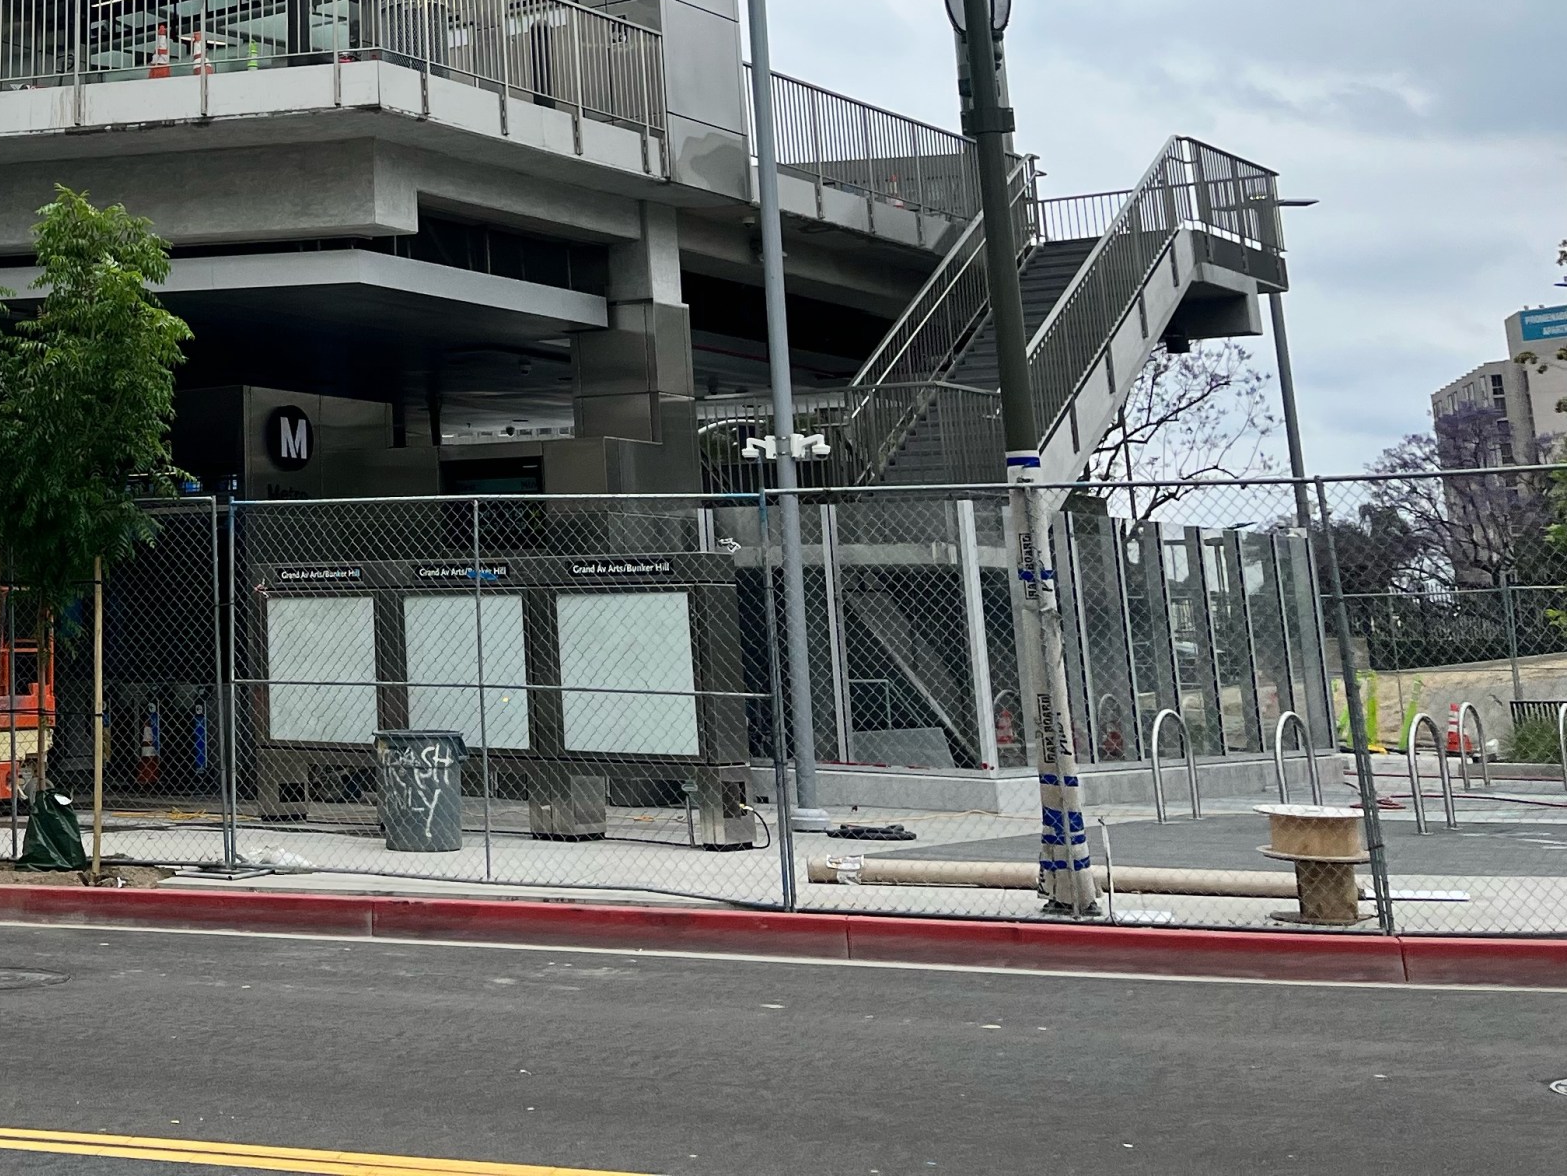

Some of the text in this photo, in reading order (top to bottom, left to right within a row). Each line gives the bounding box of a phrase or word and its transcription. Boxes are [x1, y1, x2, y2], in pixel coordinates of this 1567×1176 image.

[280, 416, 307, 460] M
[419, 568, 440, 576] Grand
[440, 568, 450, 576] Av
[572, 565, 595, 574] Grand
[597, 564, 607, 573] Av
[608, 563, 654, 573] Arts/Bunker
[281, 570, 300, 579] Grand
